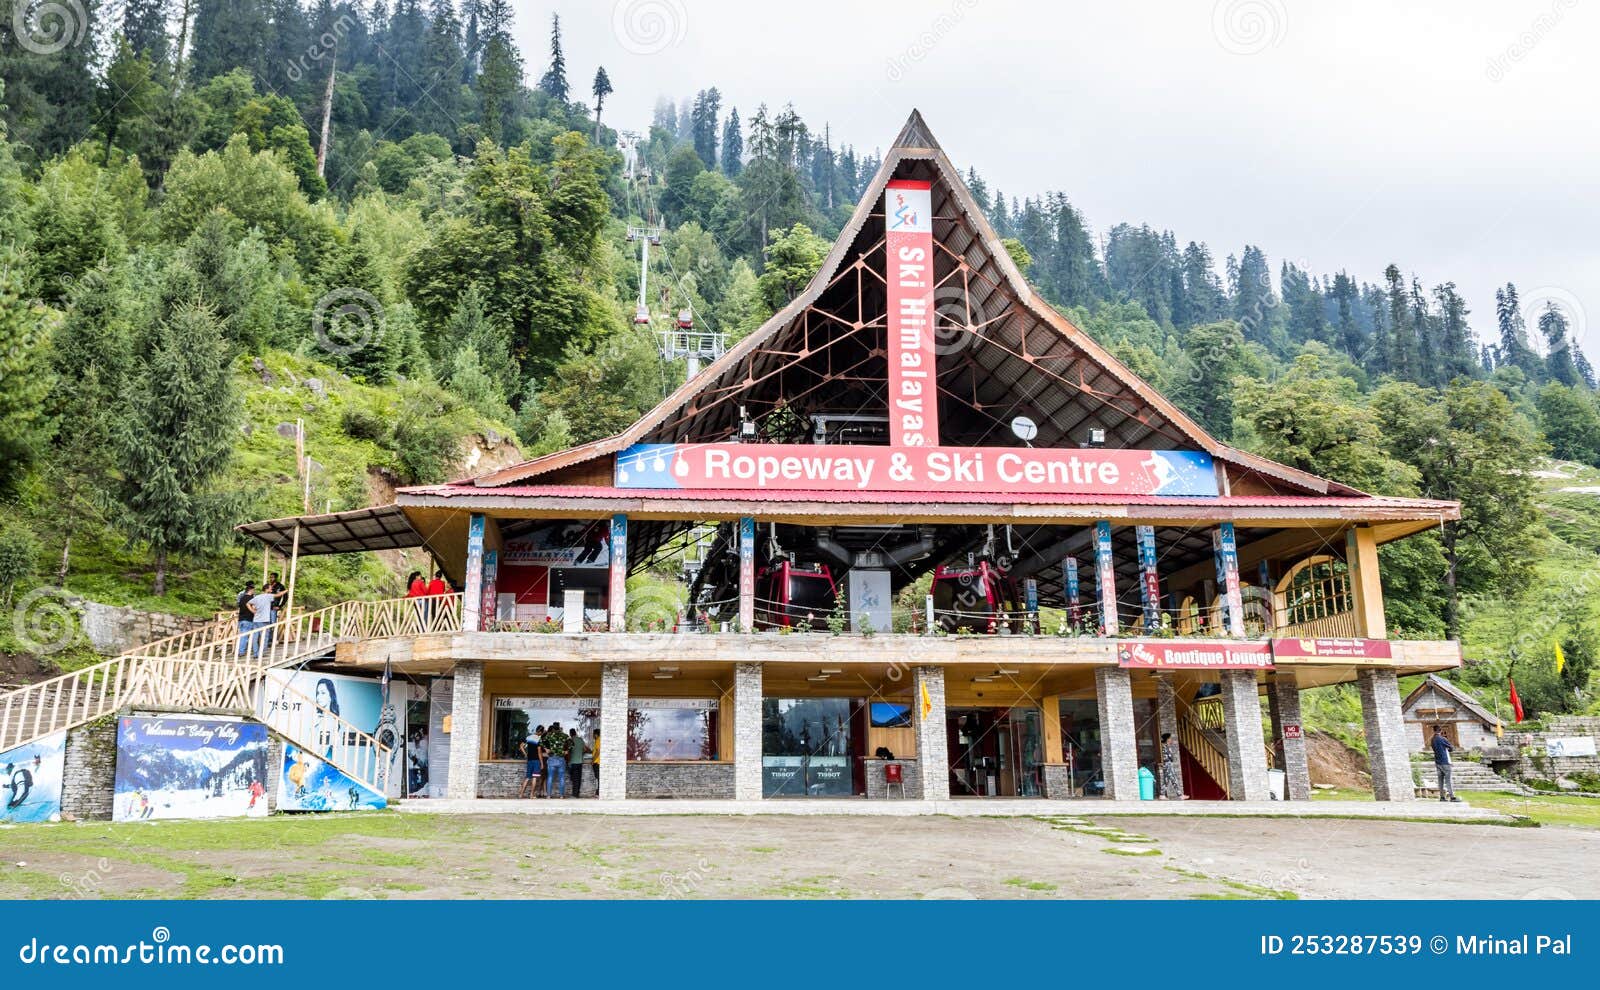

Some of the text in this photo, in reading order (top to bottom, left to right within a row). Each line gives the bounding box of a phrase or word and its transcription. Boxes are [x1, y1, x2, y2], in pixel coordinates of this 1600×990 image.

[898, 246, 925, 288] Ski
[895, 297, 928, 447] Himalayas
[704, 449, 1120, 488] Ropeway & Ski Centre
[1146, 549, 1160, 629] HIMALAYAS
[1164, 649, 1224, 666] Boutique
[1225, 650, 1272, 667] Lounge
[142, 721, 176, 736] Welcome
[177, 726, 185, 737] to
[214, 722, 240, 745] Valley
